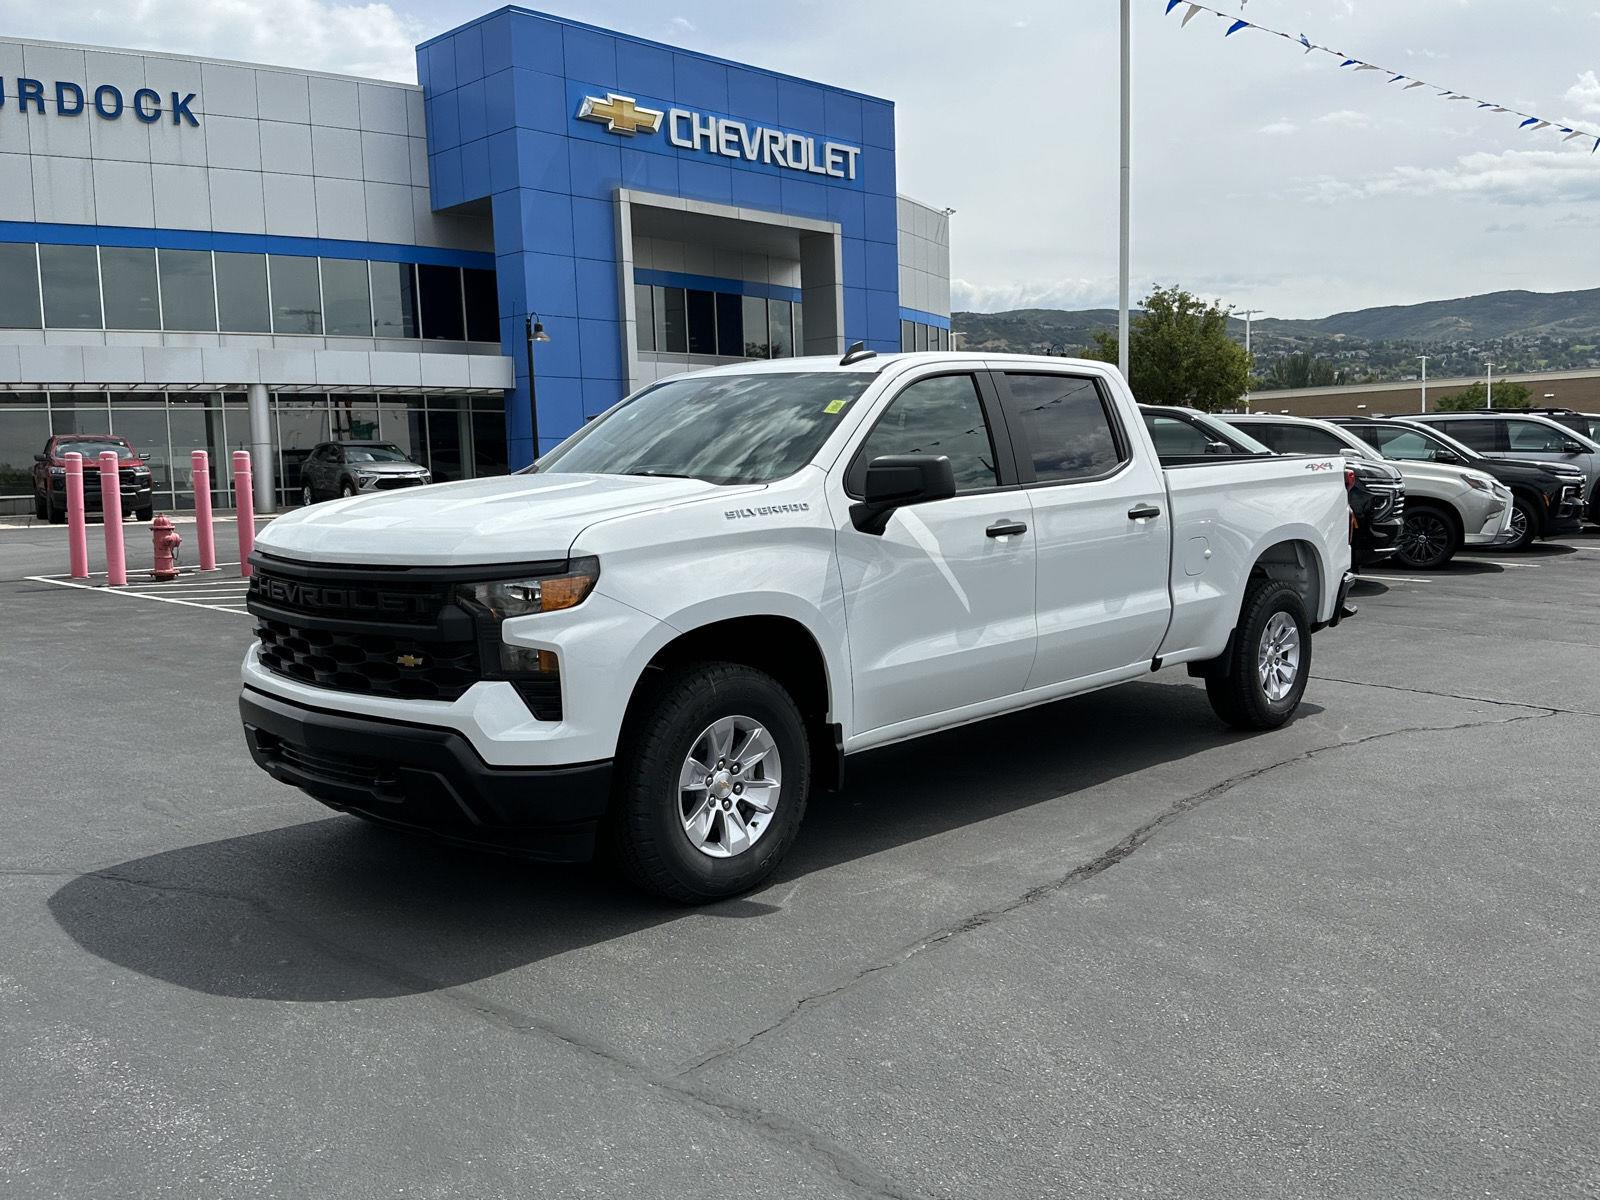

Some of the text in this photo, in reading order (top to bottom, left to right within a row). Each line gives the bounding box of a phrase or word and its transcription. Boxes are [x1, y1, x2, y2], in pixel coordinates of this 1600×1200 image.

[0, 76, 200, 127] RDOCK
[668, 107, 861, 180] CHEVROLET
[724, 502, 810, 520] SILVERADO
